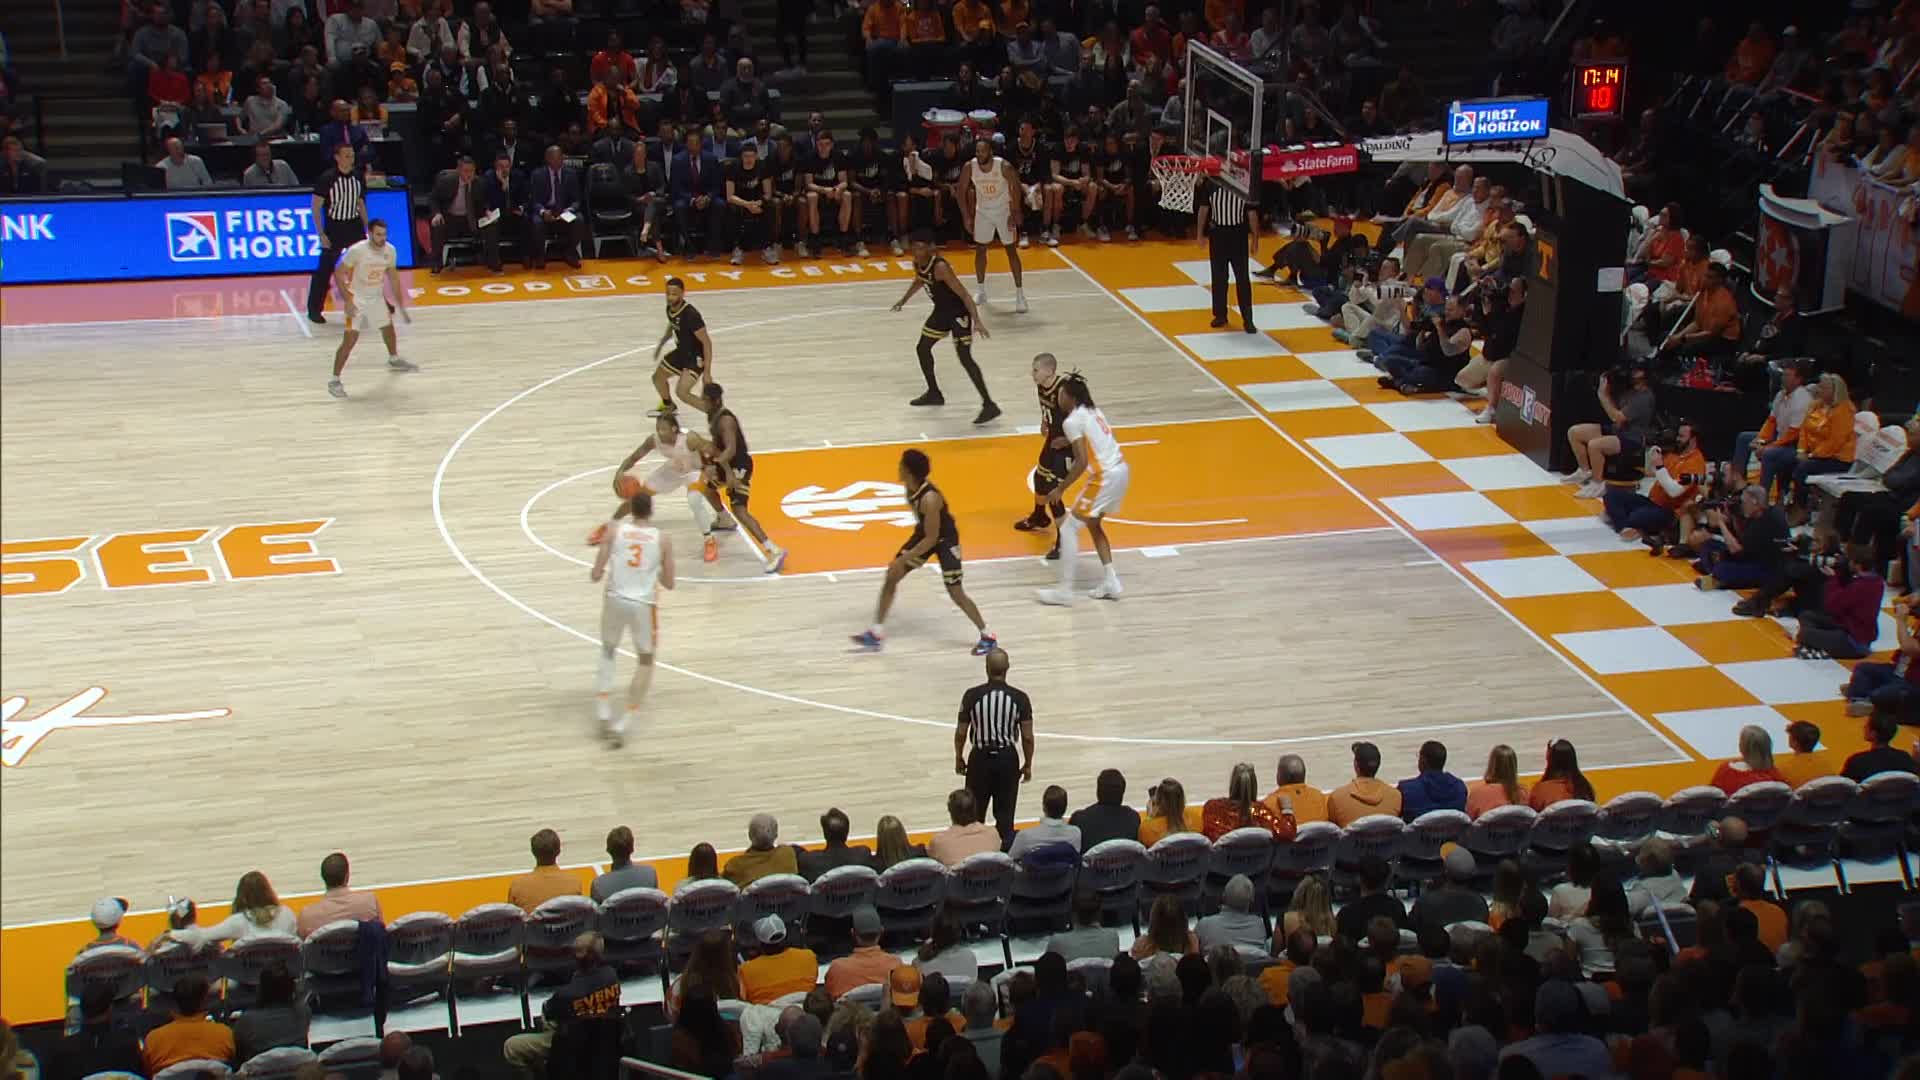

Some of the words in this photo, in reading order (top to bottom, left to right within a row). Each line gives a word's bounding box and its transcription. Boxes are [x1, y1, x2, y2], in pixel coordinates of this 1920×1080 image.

[1583, 69, 1619, 86] 17:14
[1590, 87, 1611, 108] 10
[1478, 109, 1517, 121] FIRST
[1478, 119, 1540, 134] HORIZON
[225, 207, 312, 233] FIRST
[407, 281, 553, 298] FOOD
[769, 258, 914, 279] CENTE
[780, 480, 919, 531] SEC
[1, 518, 342, 596] SEE
[626, 543, 644, 568] 3
